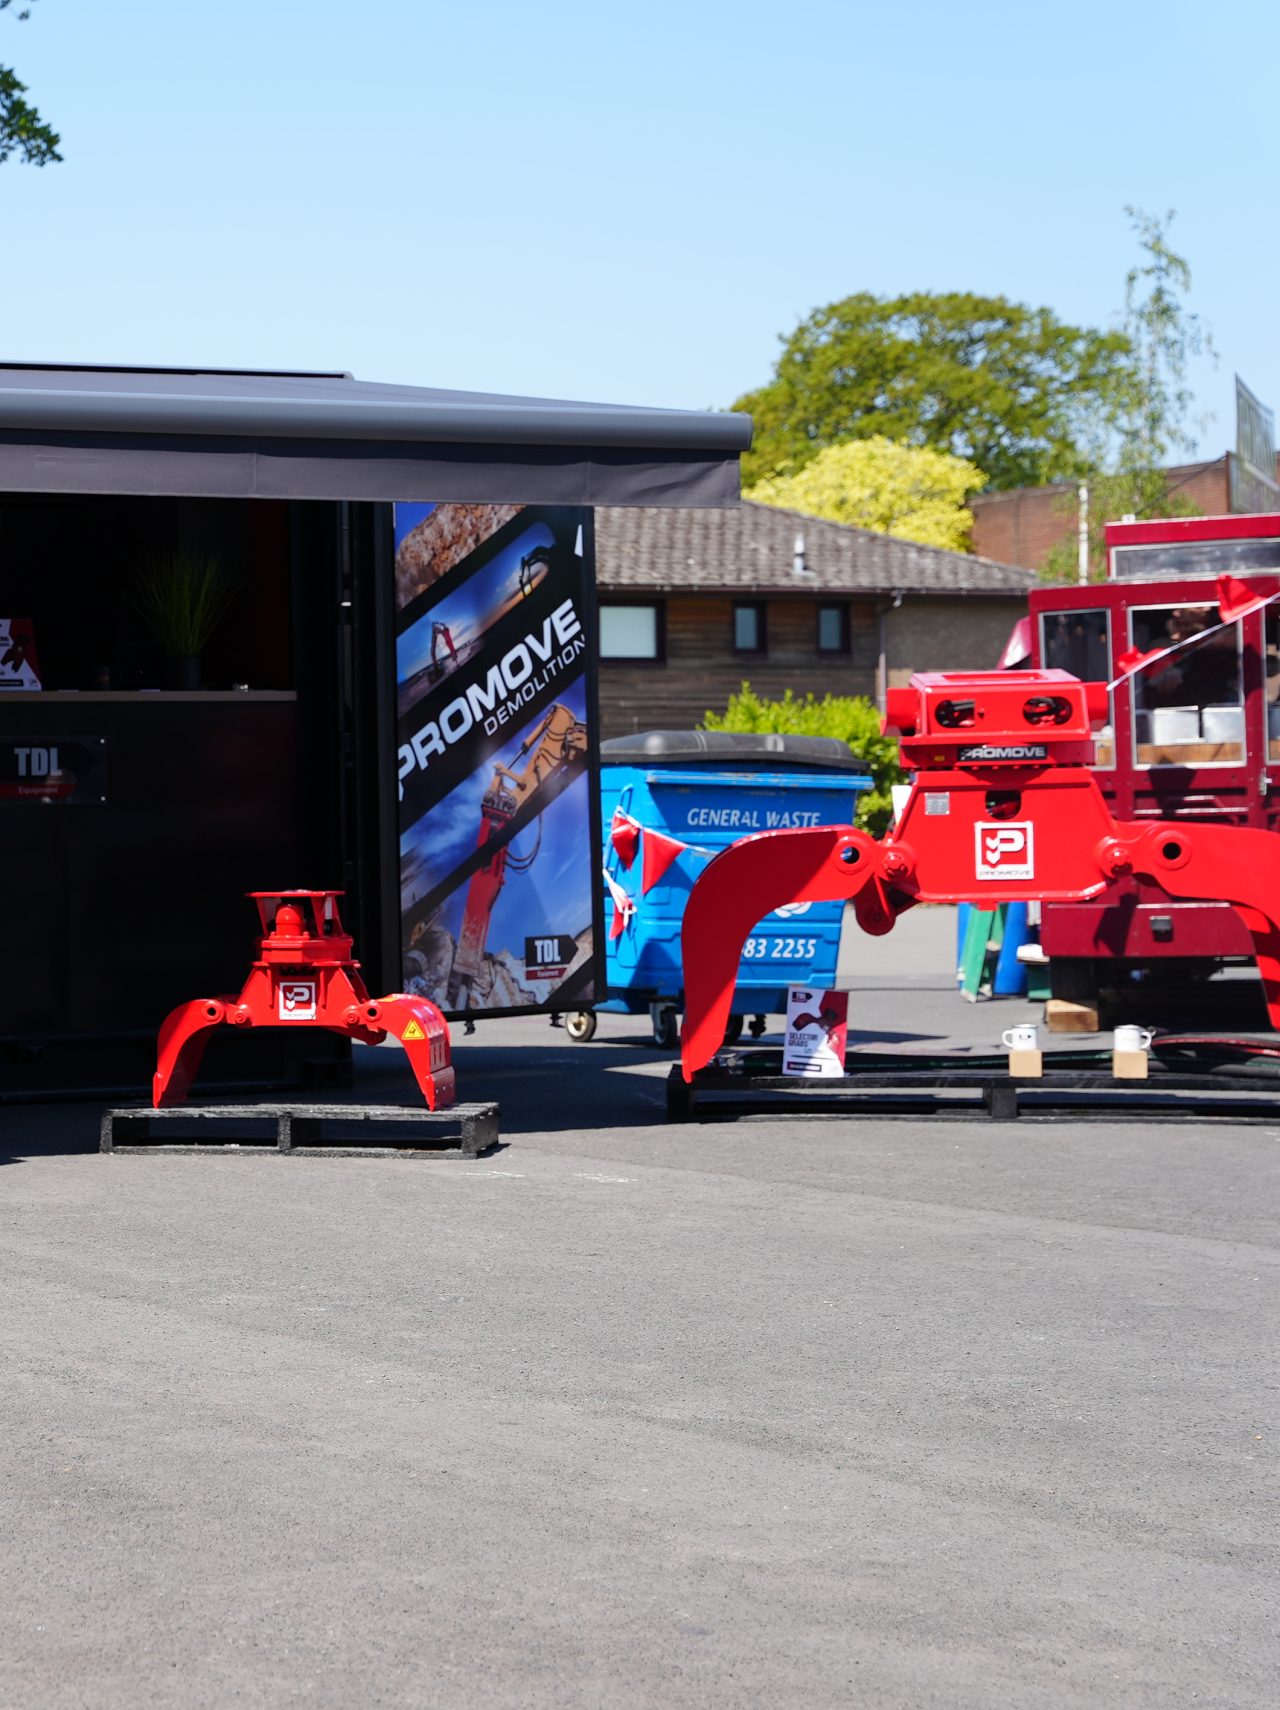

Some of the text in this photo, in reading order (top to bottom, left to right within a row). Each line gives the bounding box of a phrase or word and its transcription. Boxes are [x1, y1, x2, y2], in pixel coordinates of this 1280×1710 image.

[483, 636, 585, 736] DEMOLITION
[398, 598, 582, 801] PROMOVE
[13, 746, 63, 777] TDL
[959, 746, 1046, 761] PROMOVE
[17, 786, 59, 796] Equipment
[687, 808, 821, 829] GENERAL WASTE
[534, 938, 561, 964] TDL
[741, 938, 817, 959] 83 2255
